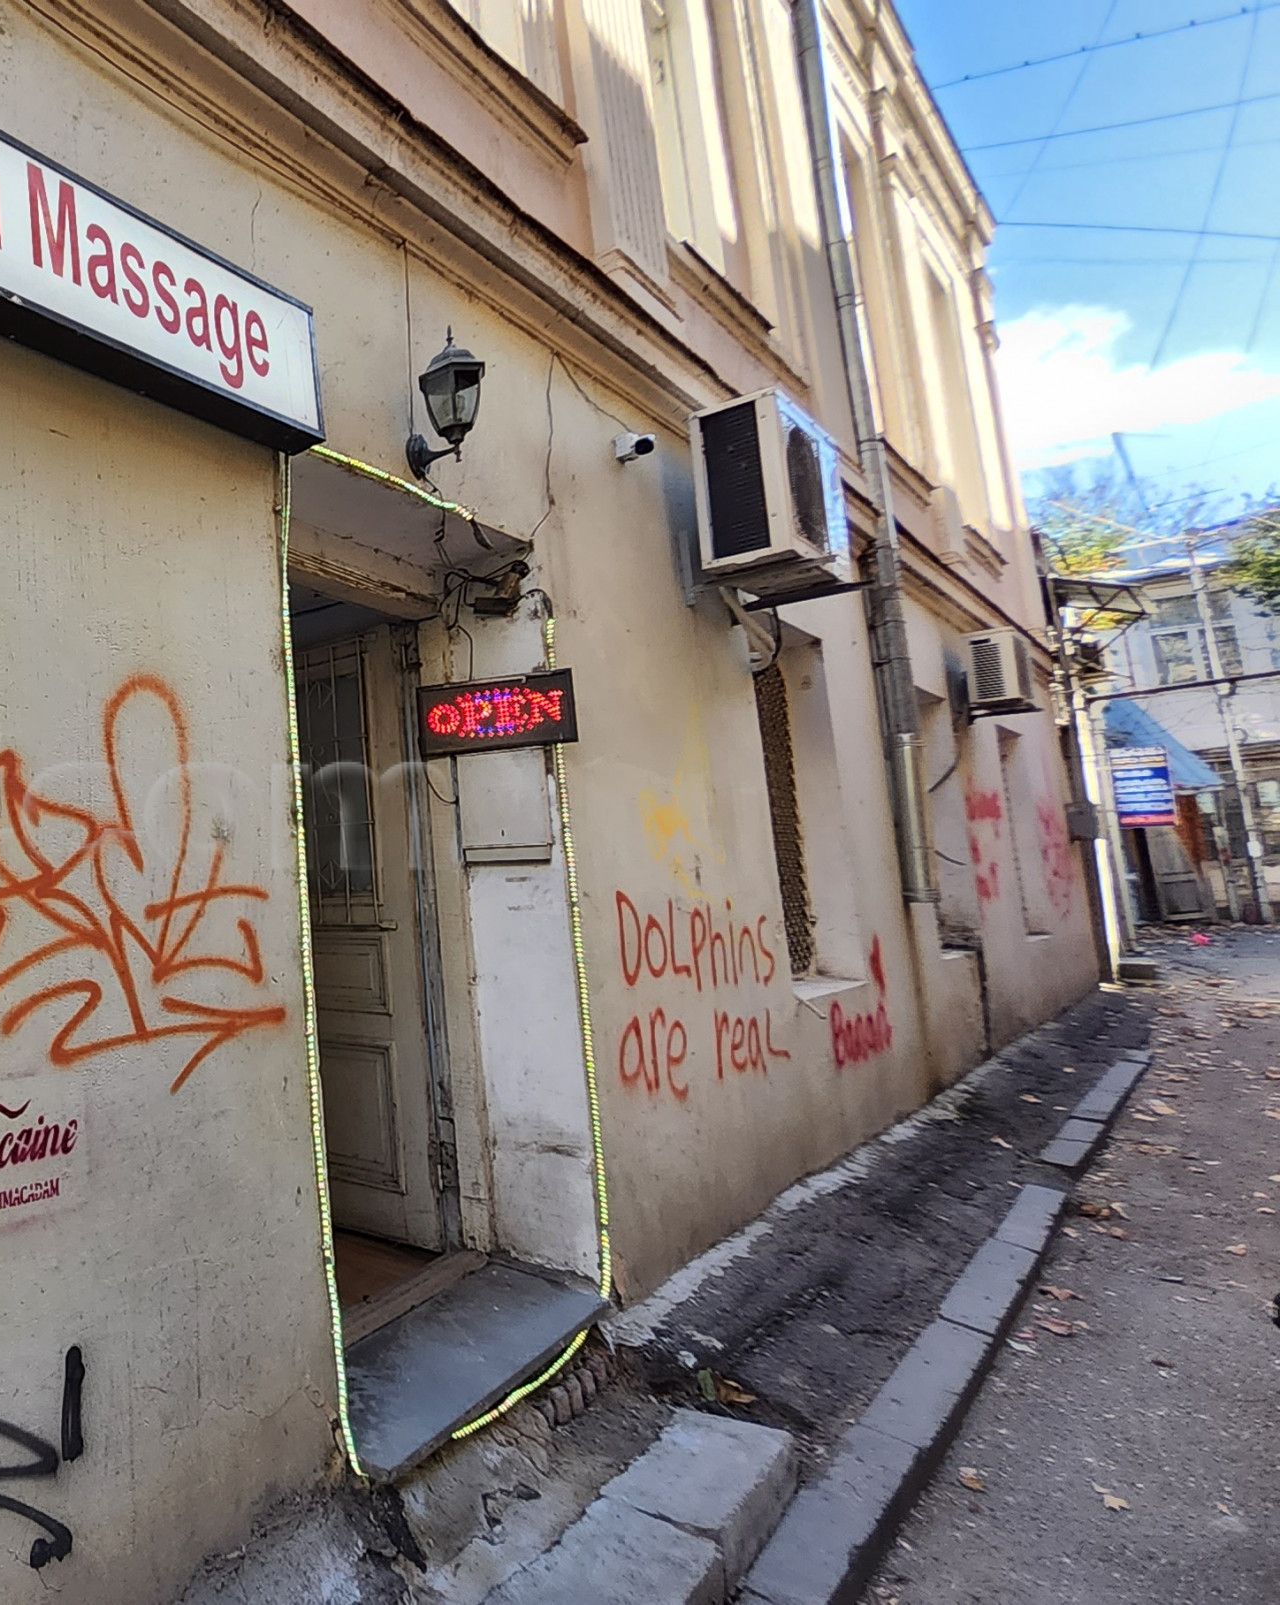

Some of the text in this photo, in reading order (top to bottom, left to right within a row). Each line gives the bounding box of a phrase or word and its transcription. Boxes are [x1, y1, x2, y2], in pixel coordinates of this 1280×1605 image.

[27, 160, 270, 389] Massage
[426, 687, 564, 736] OPEN
[620, 1006, 689, 1101] are
